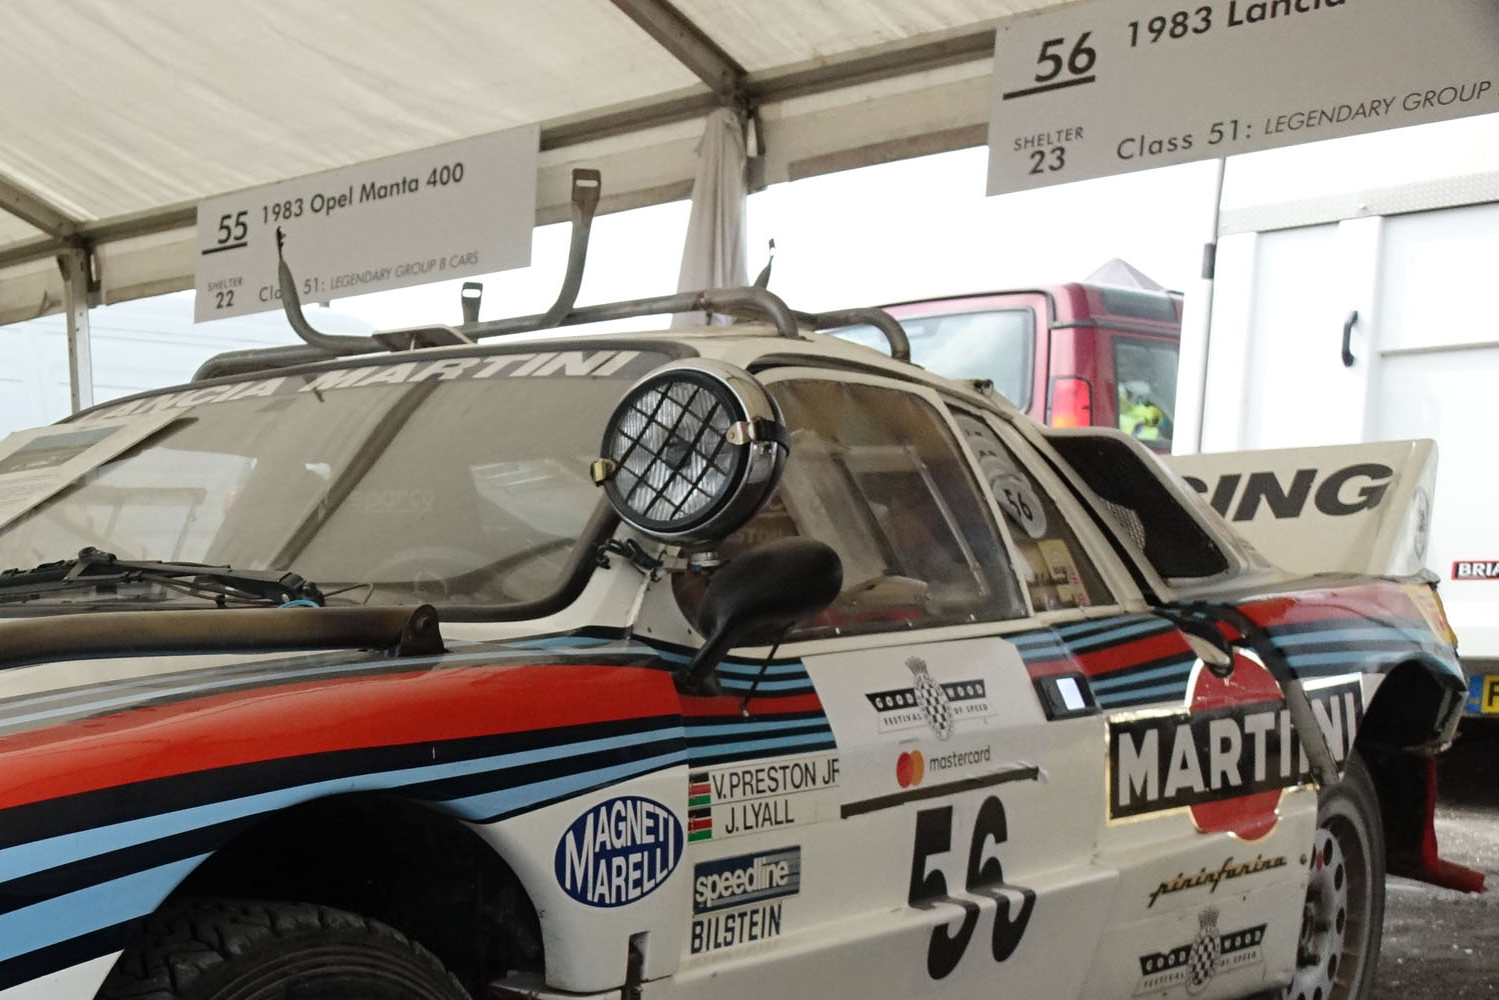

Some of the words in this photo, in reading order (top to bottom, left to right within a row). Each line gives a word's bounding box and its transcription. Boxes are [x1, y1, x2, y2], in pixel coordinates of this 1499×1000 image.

[1127, 6, 1213, 48] 1983
[1034, 30, 1097, 83] 56
[1013, 126, 1085, 151] SHELTER
[1116, 133, 1194, 161] Class
[1207, 118, 1252, 145] 51:
[1264, 95, 1397, 136] LEGENDARY
[1402, 80, 1492, 112] GROUP
[1028, 146, 1067, 175] 23
[261, 198, 304, 225] 1983
[309, 185, 354, 216] Opel
[359, 175, 420, 204] Manta
[426, 161, 465, 188] 400
[217, 209, 249, 245] 55
[215, 289, 235, 310] 22
[329, 266, 392, 291] LEGENDARY
[395, 257, 437, 279] GROUP
[297, 350, 642, 393] MARTINI
[1181, 463, 1394, 523] ING
[929, 744, 991, 772] mastercard
[565, 799, 675, 876] MAGNETI
[565, 830, 675, 904] MARELLI
[695, 856, 790, 908] speedline
[908, 795, 1037, 980] 56
[1146, 853, 1288, 909] pininfarina
[690, 903, 782, 955] BILSTEIN
